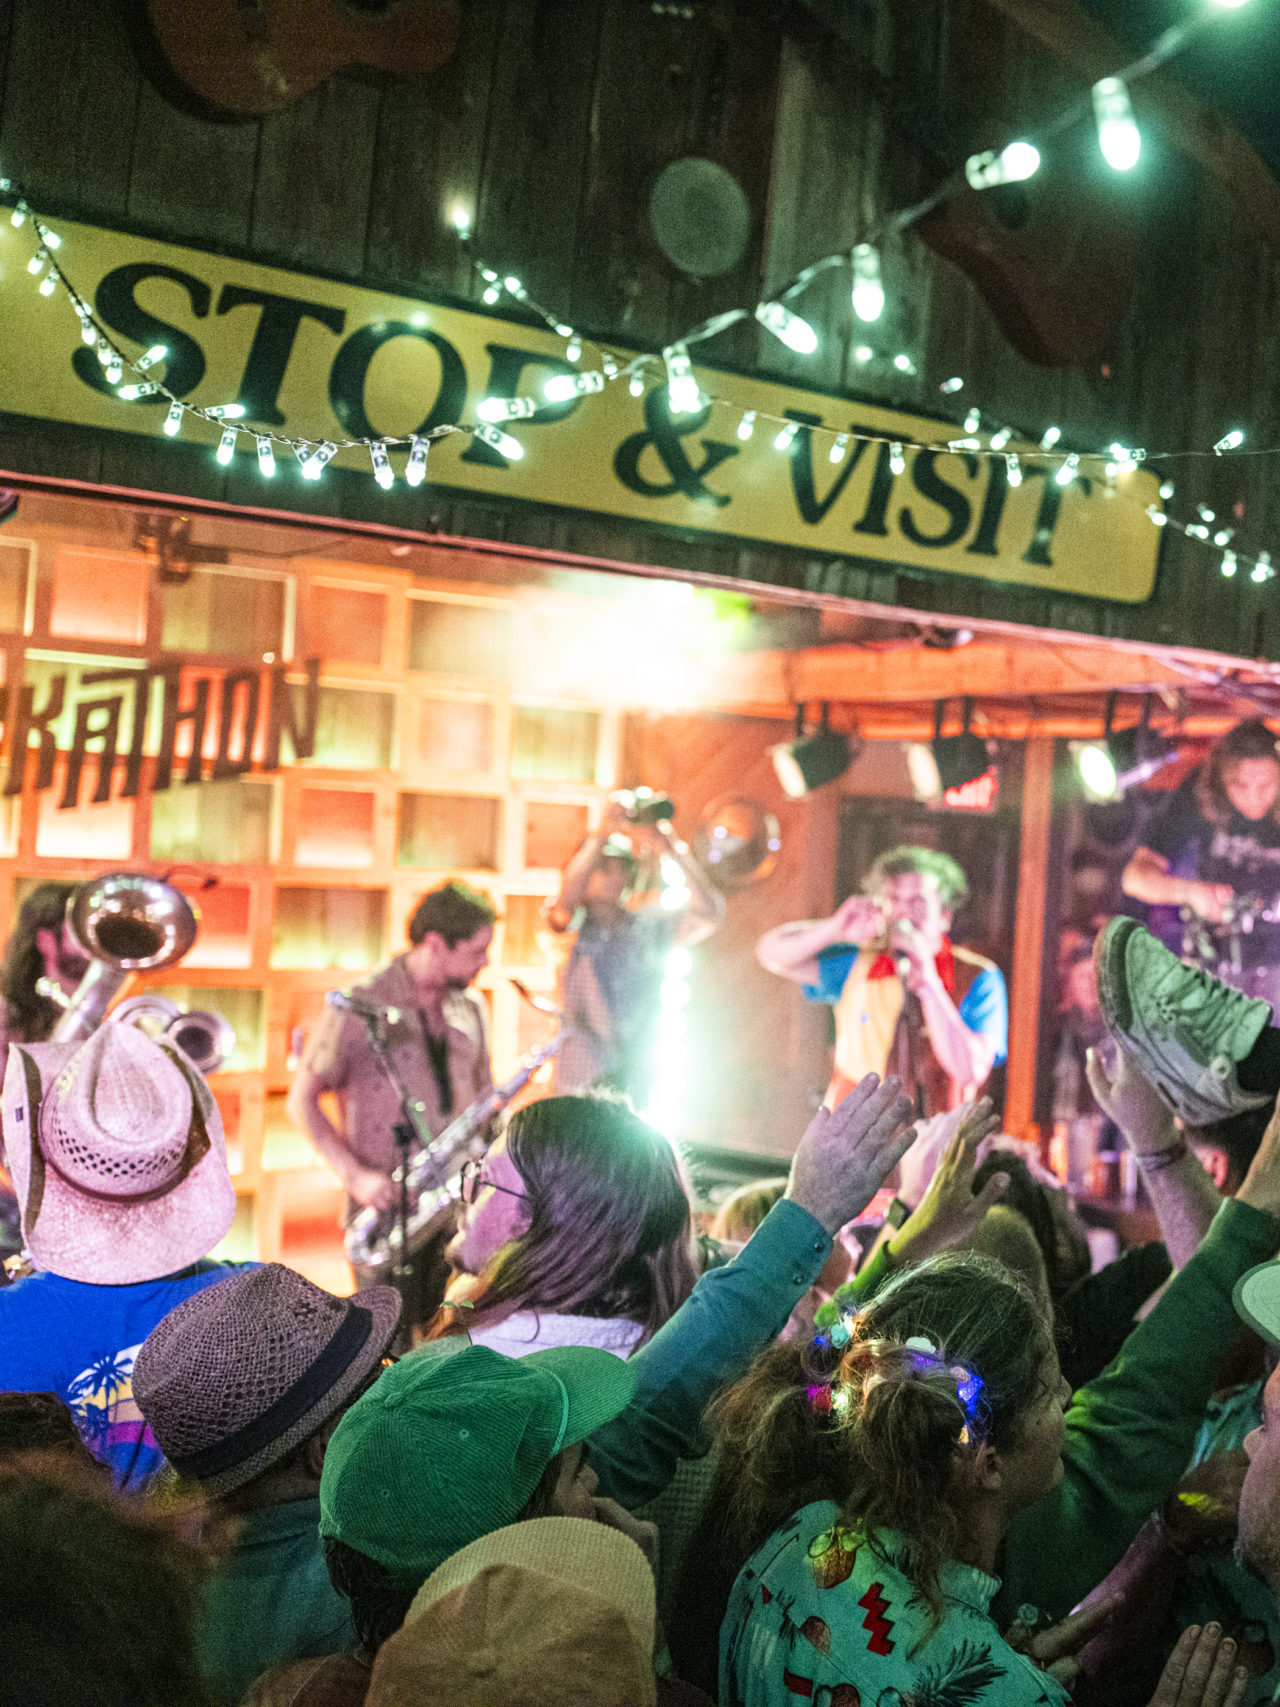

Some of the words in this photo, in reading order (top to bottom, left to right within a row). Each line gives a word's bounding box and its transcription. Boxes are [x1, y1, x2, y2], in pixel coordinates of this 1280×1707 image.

[71, 261, 583, 468] STOP
[613, 384, 740, 508] &
[782, 409, 1092, 567] VISIT
[0, 656, 321, 810] KATHON
